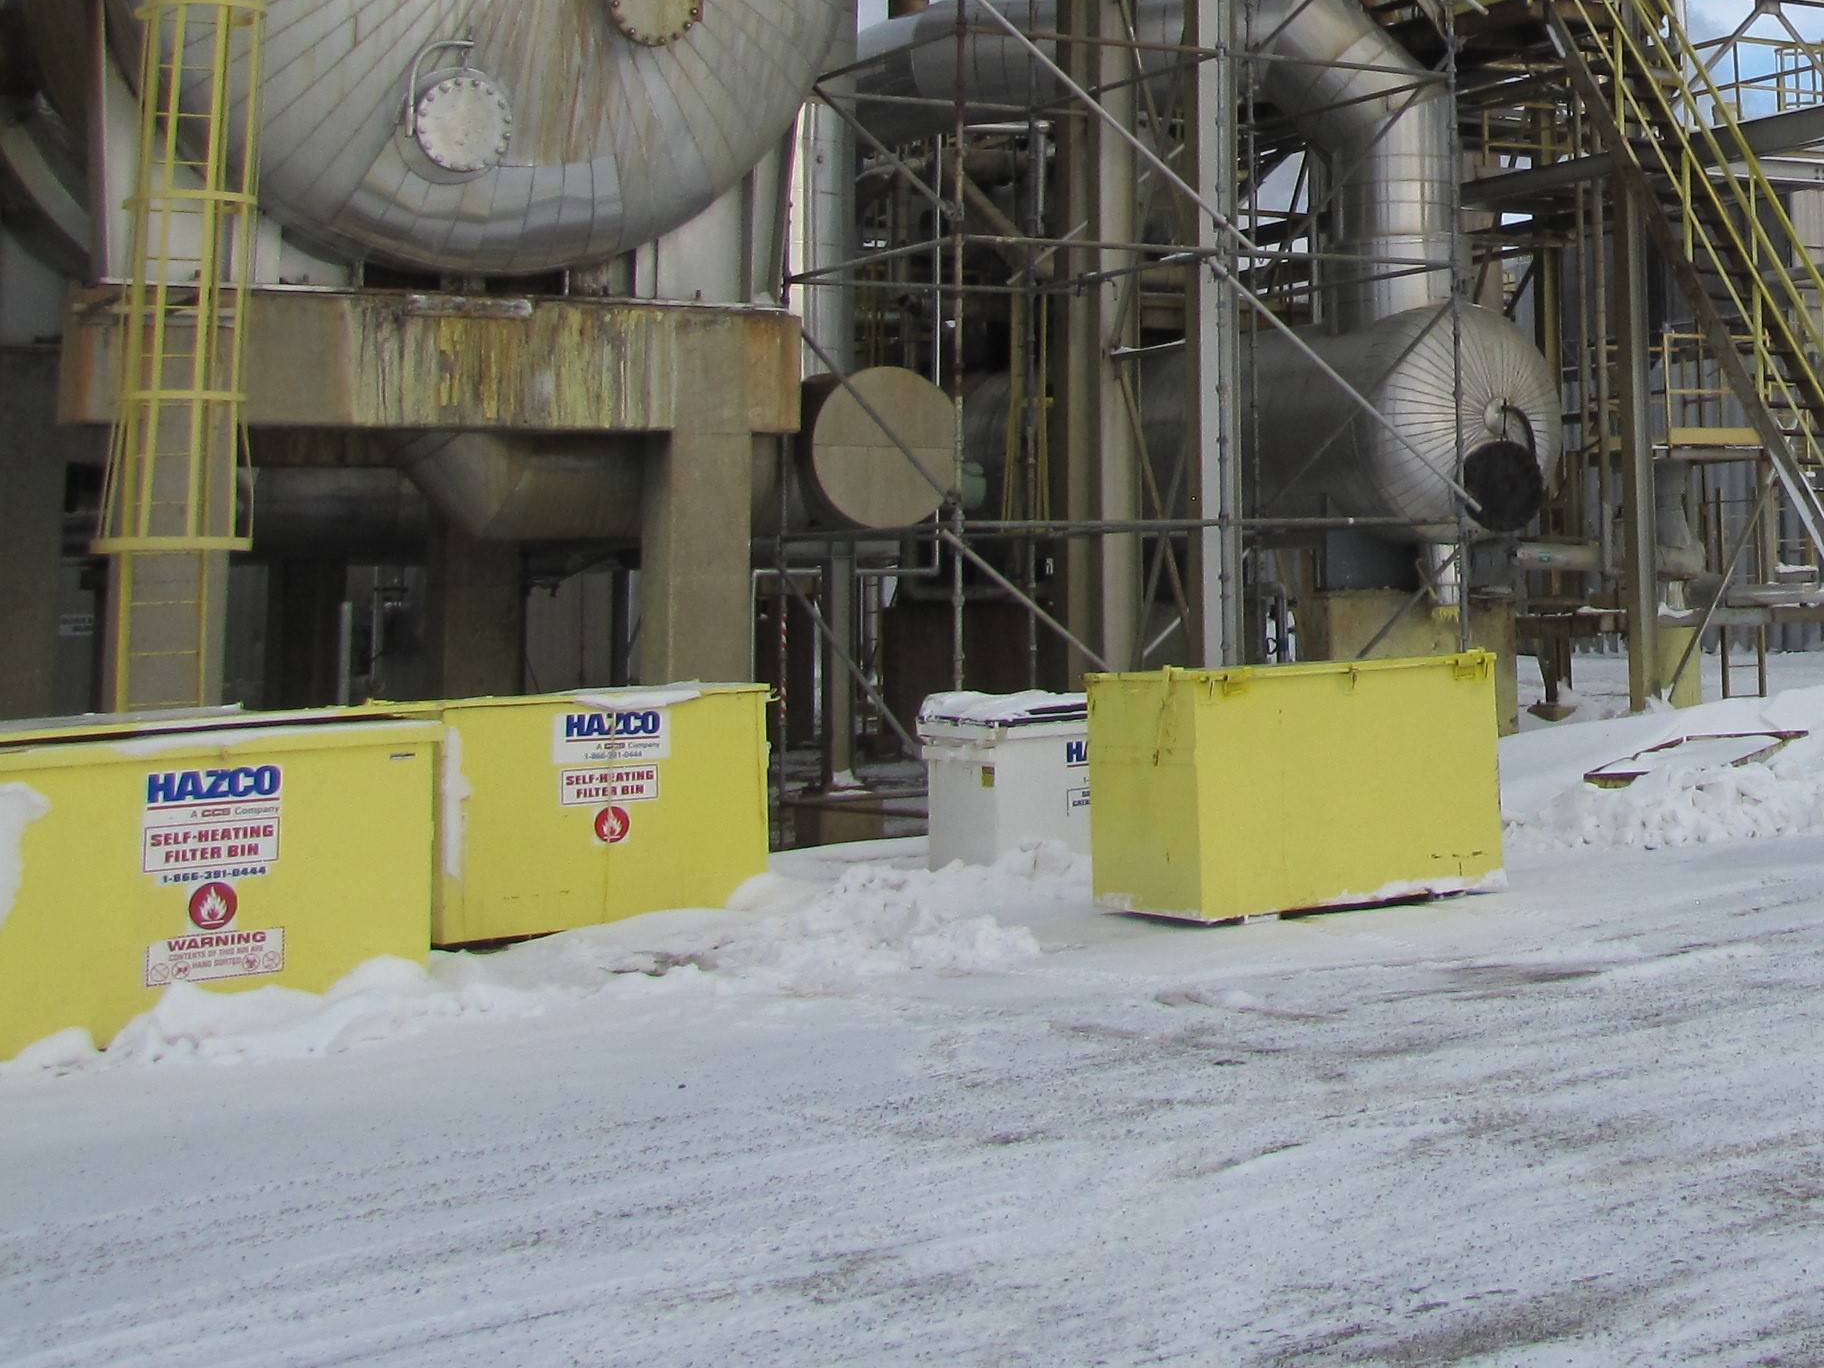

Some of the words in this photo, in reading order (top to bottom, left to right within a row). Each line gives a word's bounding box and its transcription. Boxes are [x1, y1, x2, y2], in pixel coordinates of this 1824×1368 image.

[565, 711, 660, 737] HAZCO
[628, 741, 660, 749] Company
[147, 765, 281, 803] HAZCO
[576, 786, 618, 799] FILTER
[621, 784, 645, 795] BIN
[190, 810, 199, 819] A
[234, 805, 280, 816] Company
[150, 824, 275, 847] SELF-HEATING
[164, 846, 222, 863] FILTER
[227, 843, 259, 858] BIN
[166, 931, 267, 952] WARNING
[168, 951, 207, 962] CONTENTS
